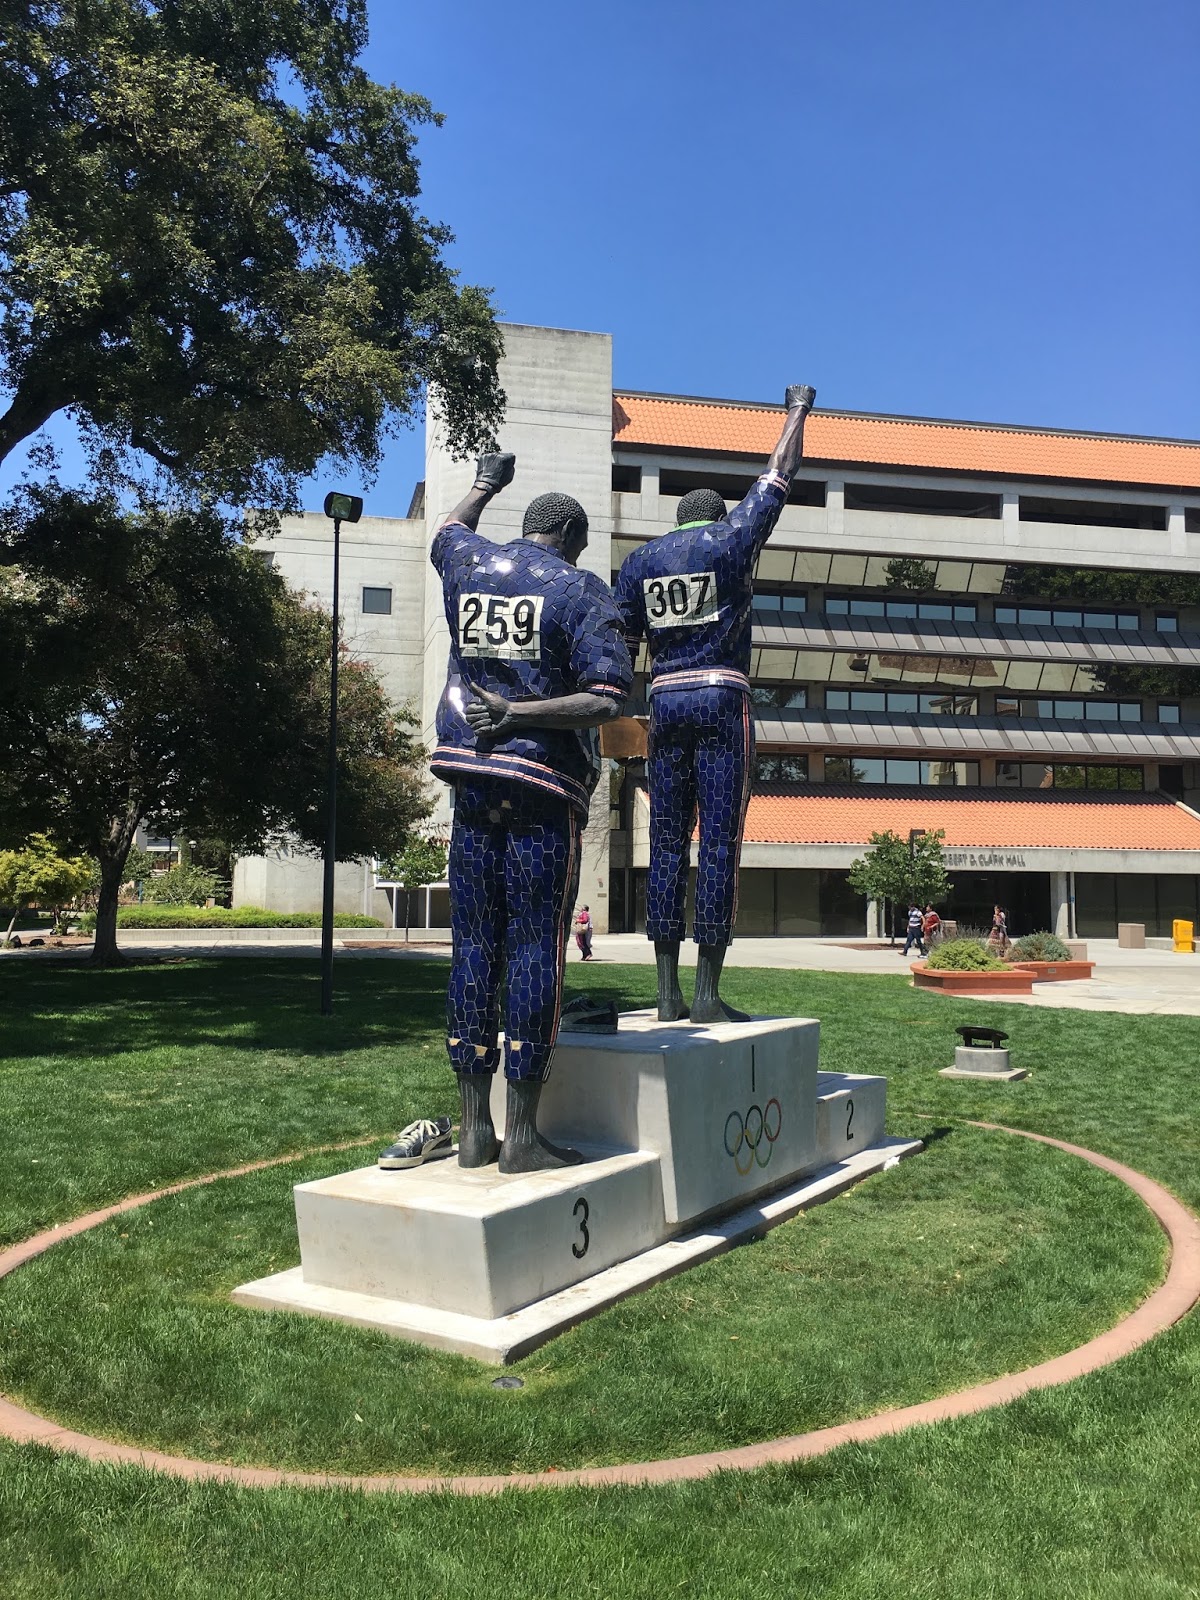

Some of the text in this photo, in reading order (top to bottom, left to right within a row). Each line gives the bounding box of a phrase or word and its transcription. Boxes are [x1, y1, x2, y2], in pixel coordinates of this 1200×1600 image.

[648, 575, 711, 618] 307
[463, 597, 535, 646] 259
[977, 854, 1005, 867] CLARK
[1005, 854, 1026, 867] HALL
[846, 1098, 854, 1140] 2
[572, 1197, 590, 1259] 3
